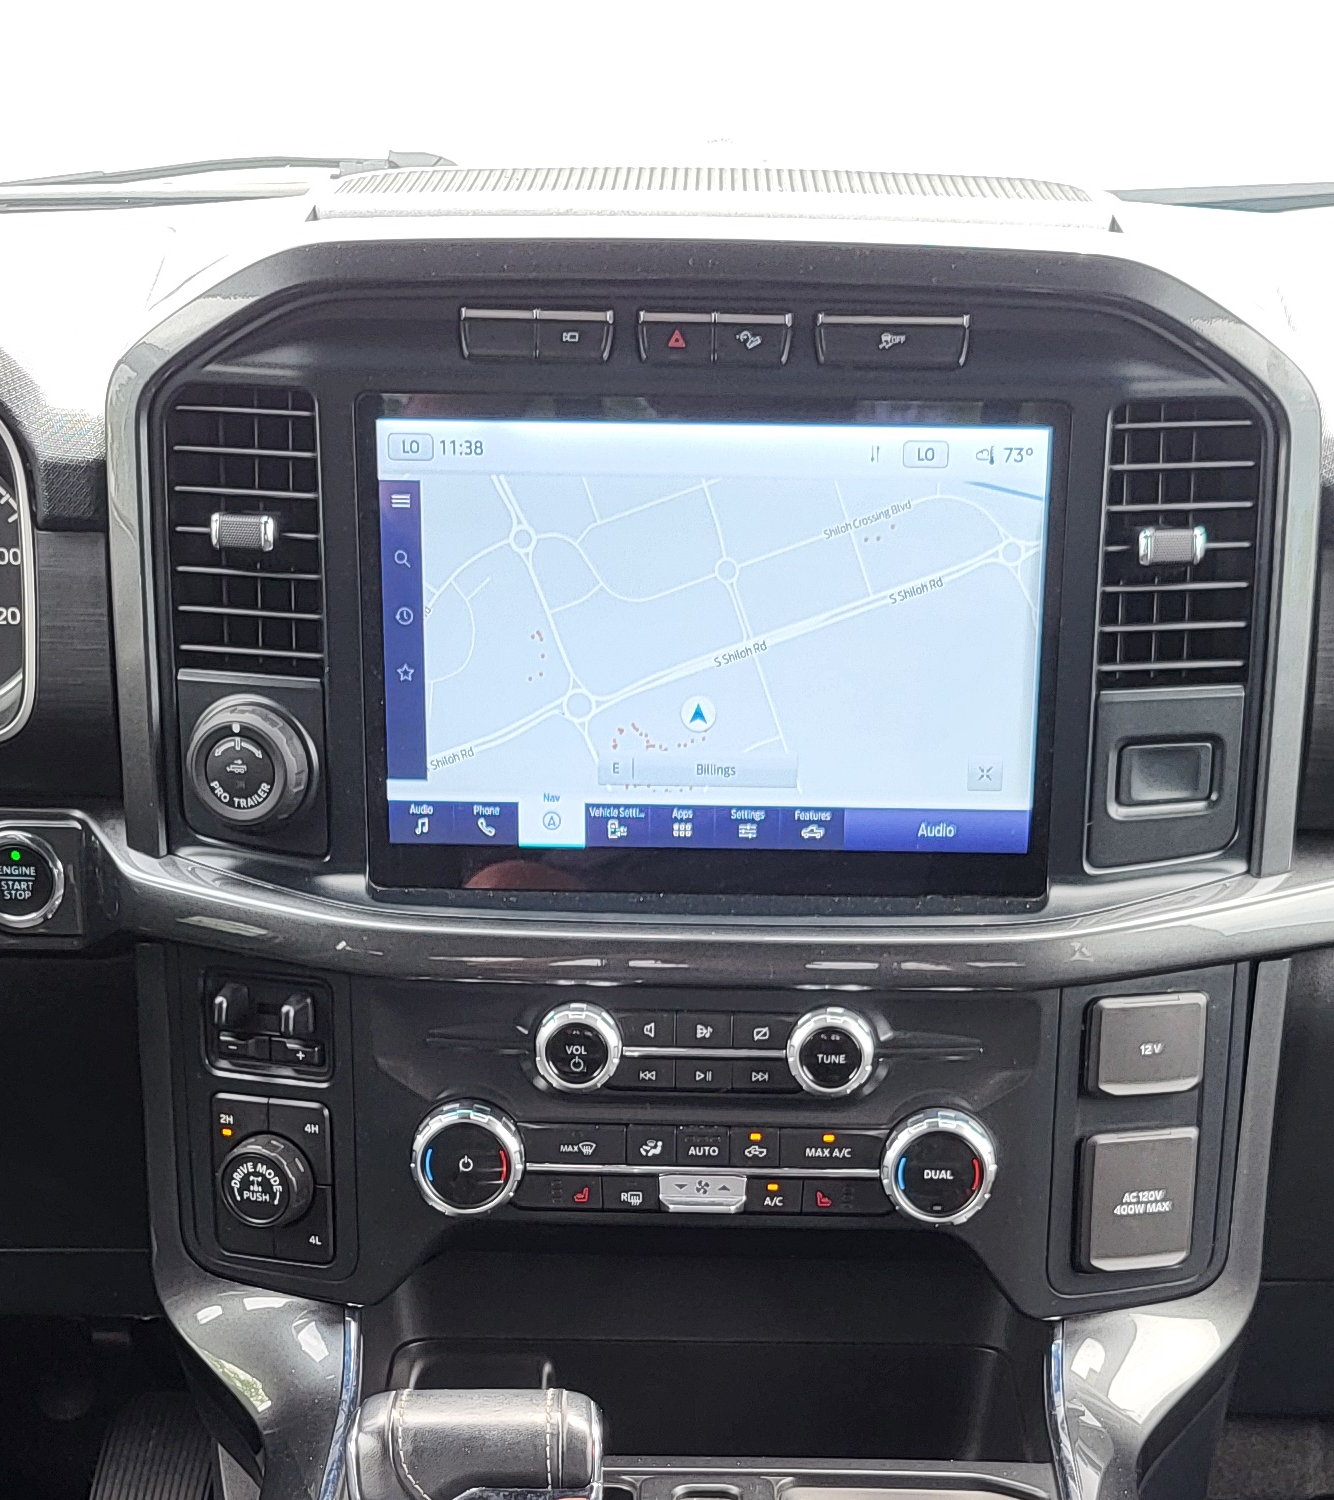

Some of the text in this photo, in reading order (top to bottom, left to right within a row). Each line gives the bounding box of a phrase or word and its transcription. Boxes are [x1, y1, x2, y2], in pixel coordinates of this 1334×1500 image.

[402, 439, 420, 454] LO
[439, 439, 484, 456] 11:38
[917, 447, 935, 461] LO
[823, 499, 912, 540] Shiloh Crossing Blvd
[889, 577, 944, 604] S Shiloh Rd
[713, 640, 768, 668] S Shiloh Rd
[430, 746, 475, 770] Shiloh Rd
[612, 762, 620, 775] E
[696, 763, 736, 778] Billings
[210, 780, 271, 808] PRO TRAILER
[543, 793, 560, 803] Nav
[409, 803, 434, 815] Audio
[473, 804, 500, 816] Phone
[588, 806, 618, 818] Vehicle
[672, 808, 693, 820] Apps
[730, 809, 765, 821] Settings
[795, 810, 831, 821] Features
[917, 821, 955, 838] Audio
[1, 881, 34, 891] START
[3, 890, 32, 900] STOP
[566, 1045, 588, 1055] VOL
[817, 1054, 846, 1064] TUNE
[219, 1114, 234, 1124] 2H
[304, 1124, 319, 1134] 4H
[559, 1144, 579, 1153] MAX
[688, 1146, 719, 1157] AUTO
[805, 1147, 852, 1158] MAX A/C
[231, 1162, 283, 1192] DRIVE MODE
[923, 1169, 954, 1180] DUAL
[243, 1191, 270, 1202] PUSH
[764, 1196, 784, 1207] A/C
[1138, 1189, 1166, 1202] 120V
[1113, 1201, 1172, 1215] 400W MAX
[309, 1235, 322, 1245] 4L
